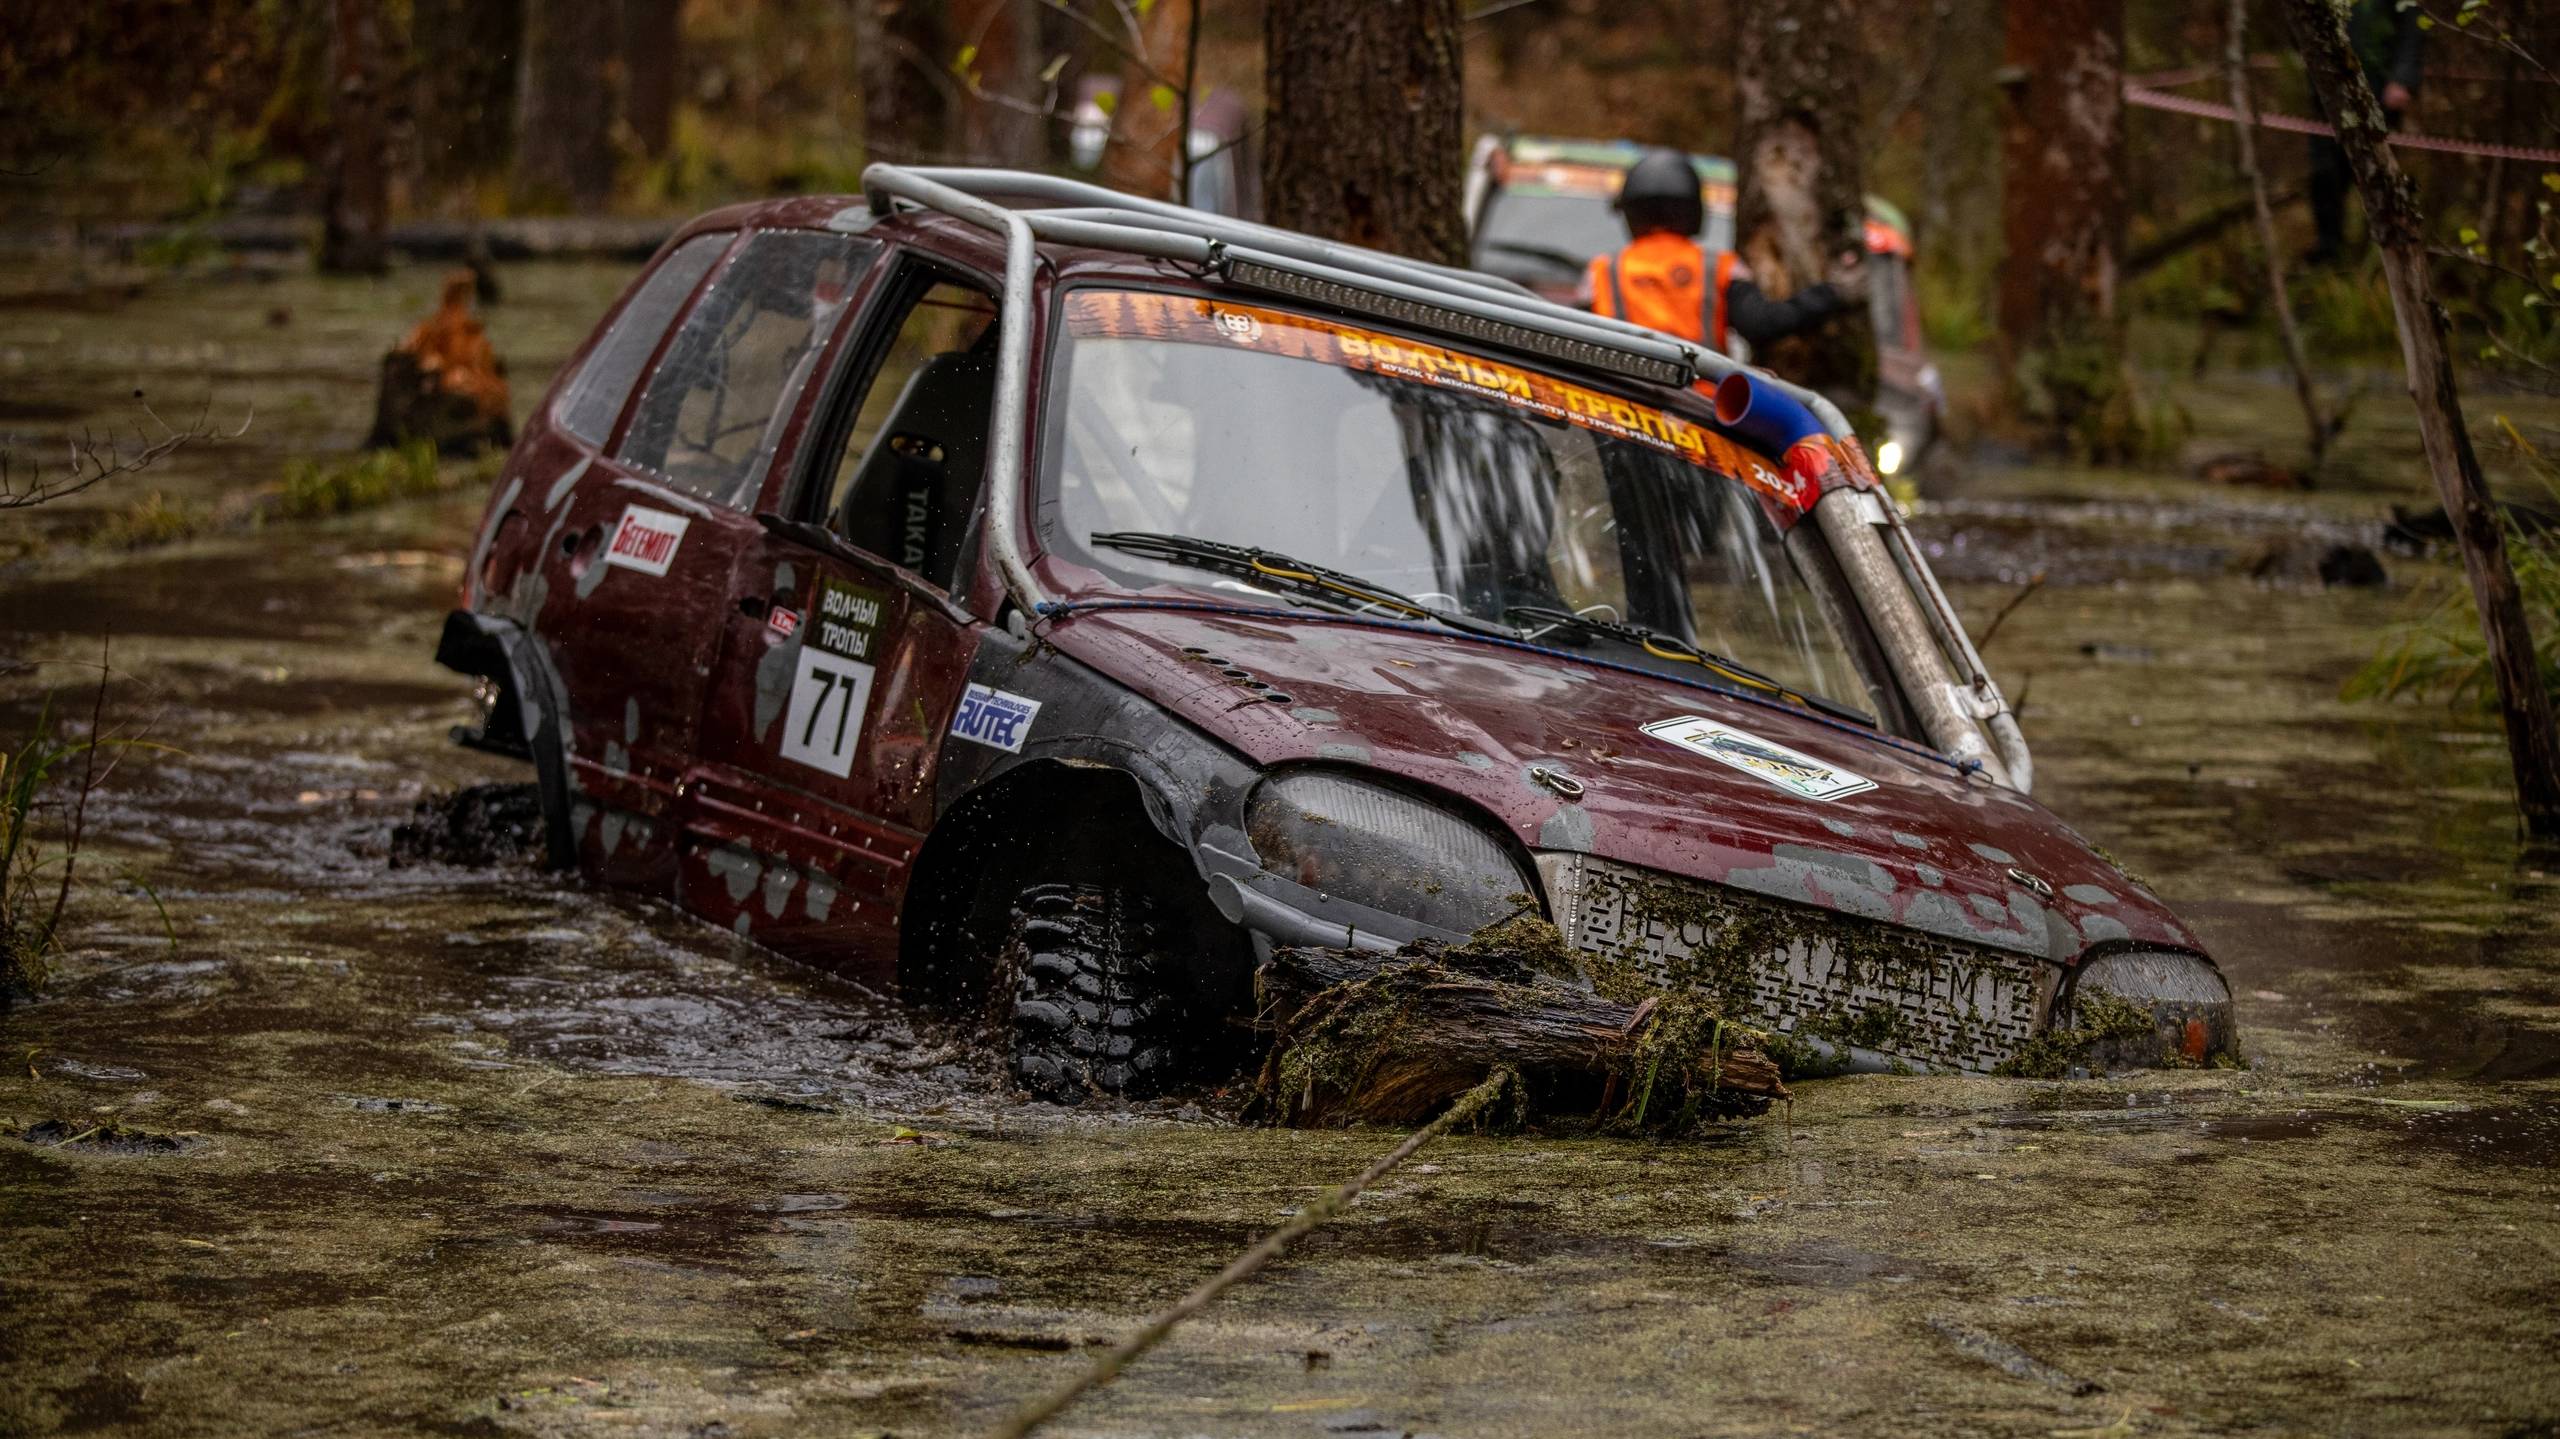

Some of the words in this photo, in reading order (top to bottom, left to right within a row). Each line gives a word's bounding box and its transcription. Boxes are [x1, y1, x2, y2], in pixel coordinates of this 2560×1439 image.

[1510, 393, 1566, 417] ОБЛАСТИ
[1554, 384, 1707, 456] ТРОПЫ
[1751, 463, 1807, 500] 2024
[612, 514, 677, 565] БЕГЕМОТ
[822, 621, 870, 658] ТРОПЫ
[802, 666, 857, 756] 71
[953, 698, 1027, 747] RUTEC
[1619, 892, 1665, 940] НЕ
